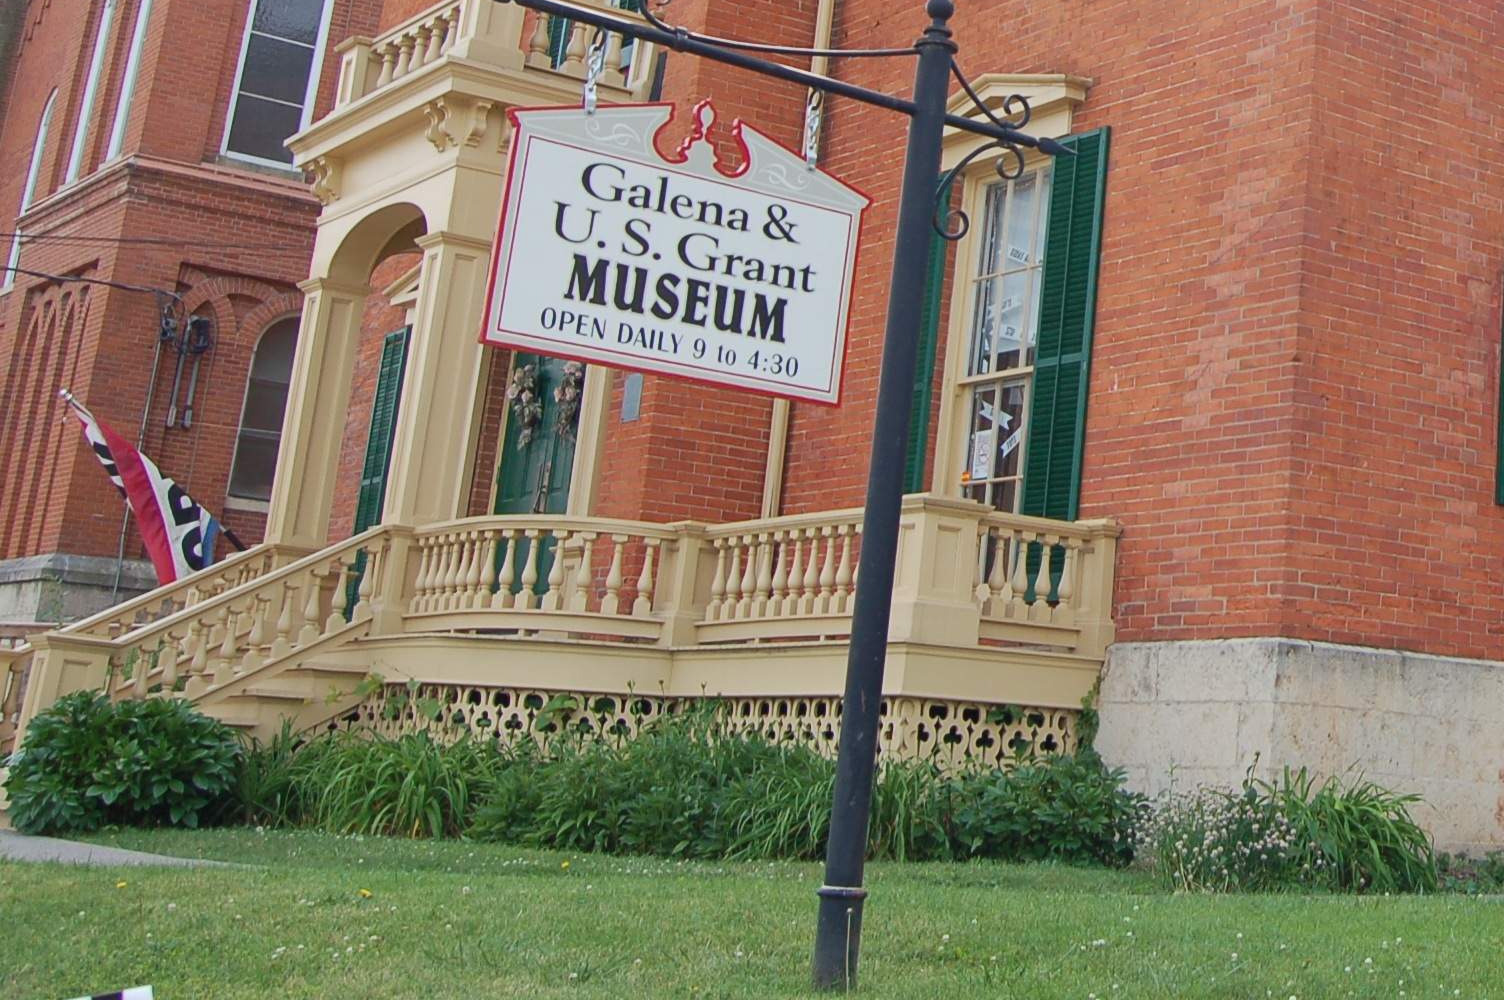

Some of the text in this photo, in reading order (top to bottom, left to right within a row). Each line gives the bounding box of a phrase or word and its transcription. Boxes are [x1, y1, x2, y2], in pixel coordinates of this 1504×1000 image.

[581, 162, 800, 244] Galena &
[564, 253, 788, 343] MUSEUM
[677, 232, 817, 293] Grant
[540, 307, 799, 378] OPEN DAILY 9 to 4:30
